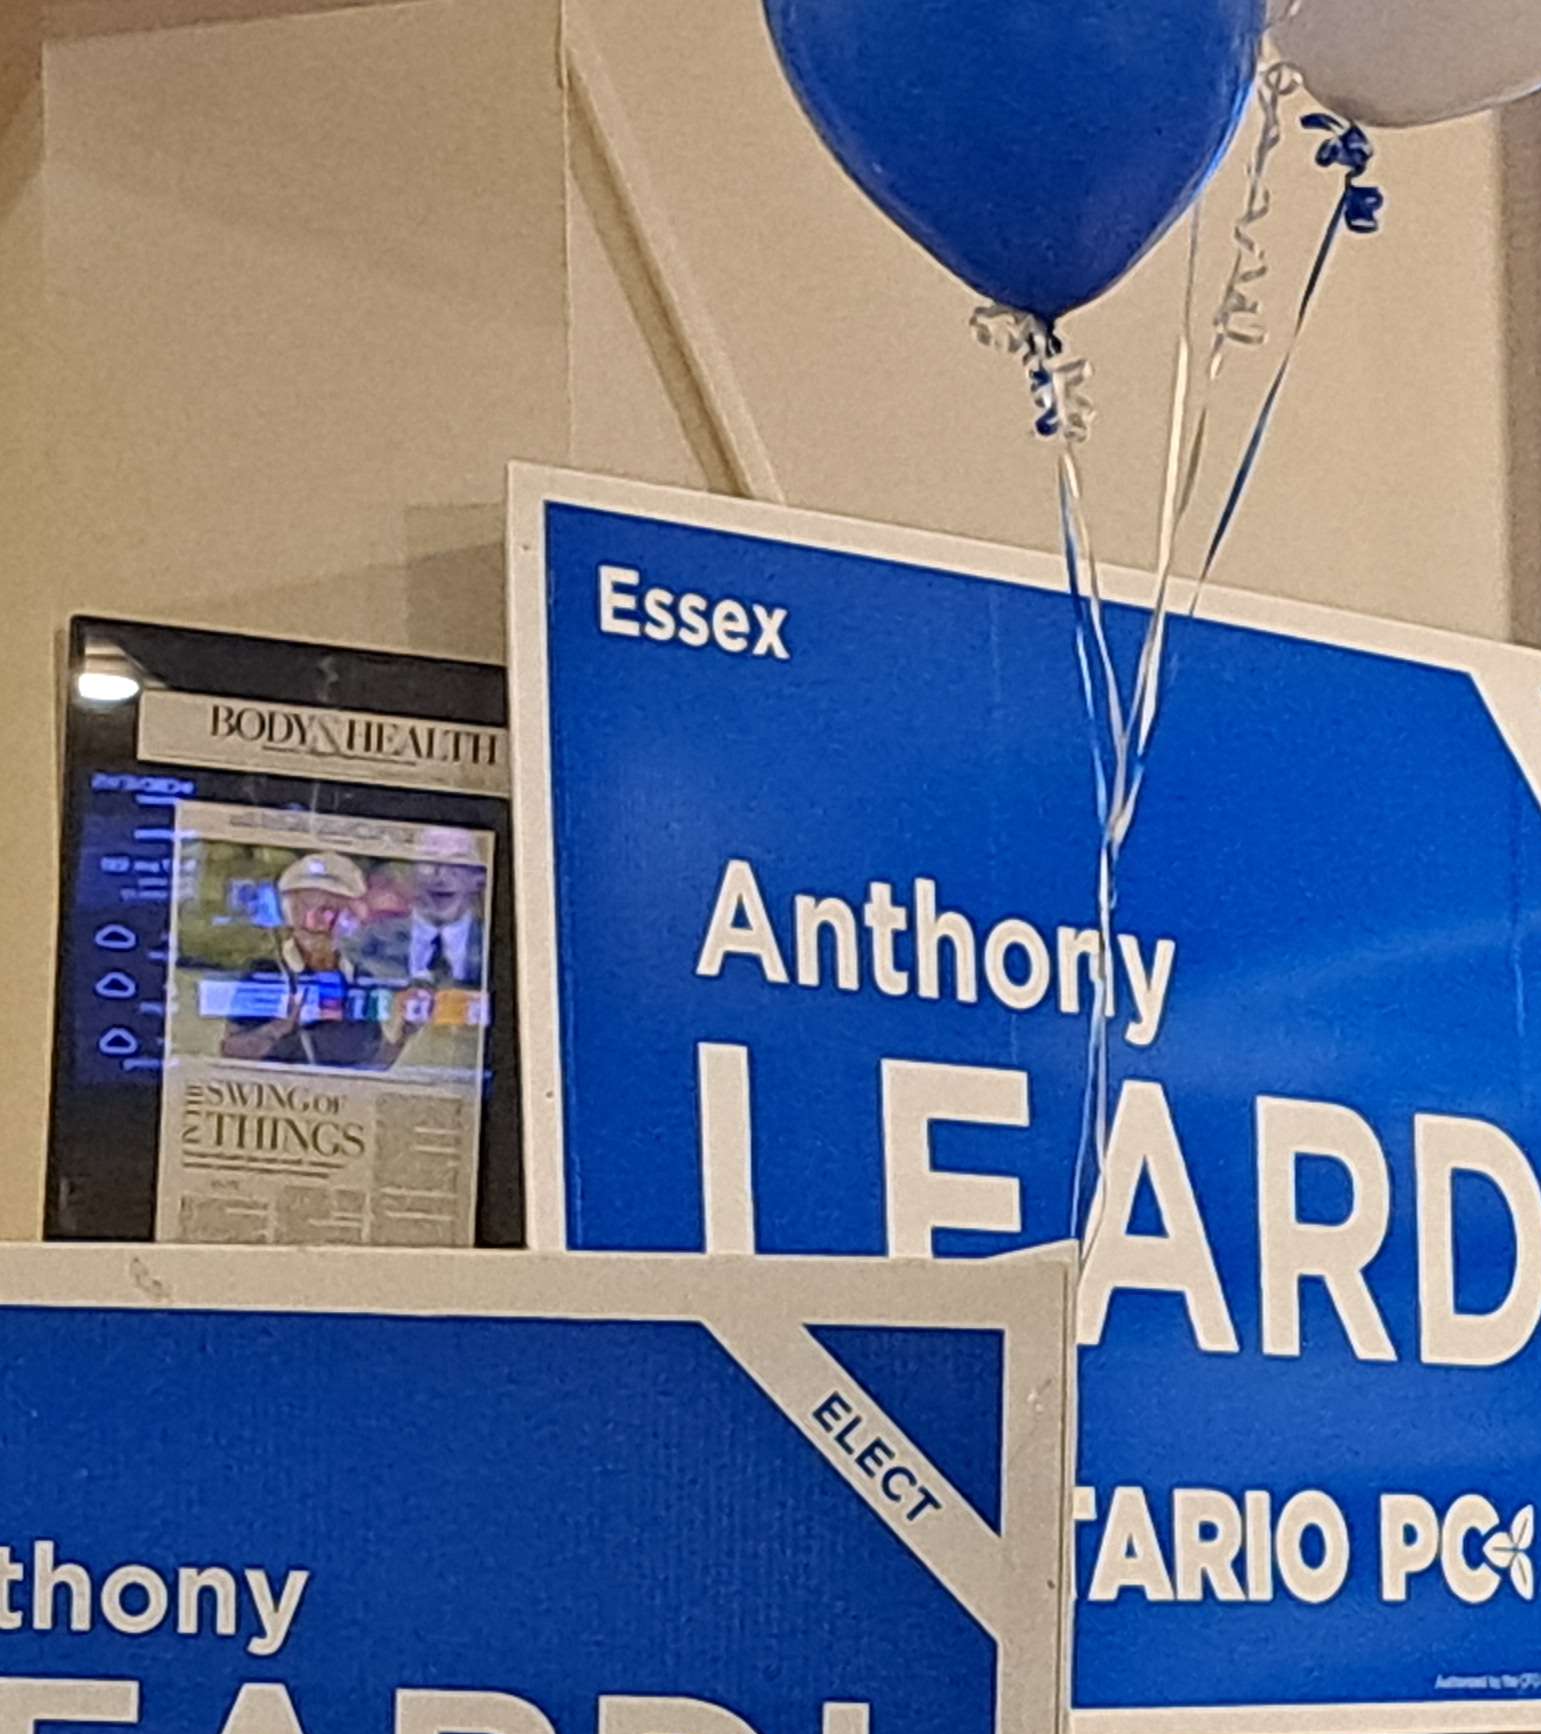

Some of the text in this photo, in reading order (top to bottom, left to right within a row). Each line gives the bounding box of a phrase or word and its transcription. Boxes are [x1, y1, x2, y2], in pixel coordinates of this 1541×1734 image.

[598, 564, 791, 661] Essex
[696, 857, 1175, 1047] Anthony
[205, 1080, 309, 1114] SWING
[313, 1094, 348, 1114] OF
[206, 1110, 365, 1158] THINGS
[811, 1392, 942, 1526] ELECT
[0, 1540, 309, 1656] thony
[1073, 1486, 1500, 1604] ARIO PC
